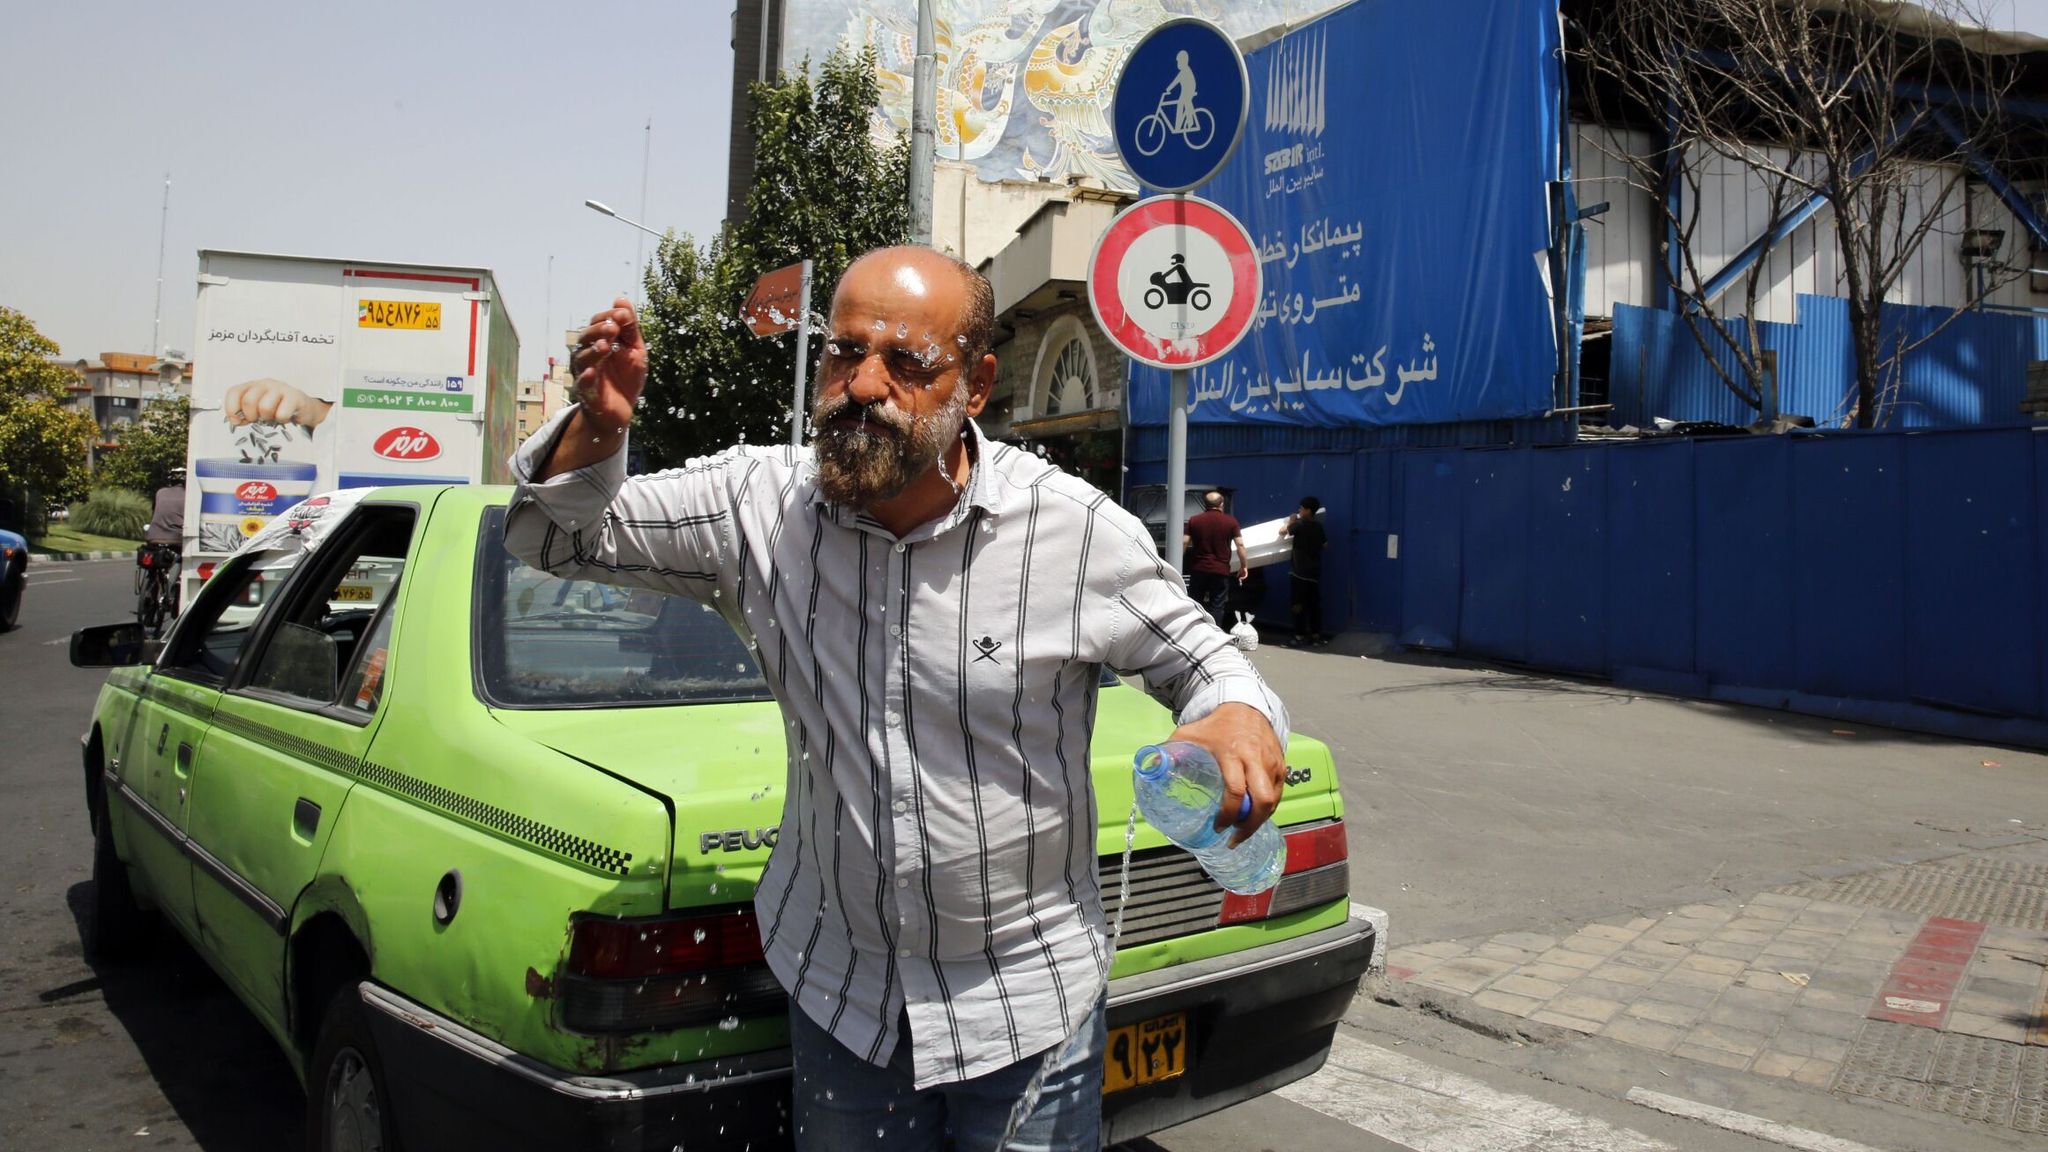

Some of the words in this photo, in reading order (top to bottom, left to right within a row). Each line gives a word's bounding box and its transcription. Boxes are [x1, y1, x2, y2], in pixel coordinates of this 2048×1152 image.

[1286, 217, 1363, 269] پیمانکار
[425, 316, 439, 328] ۵۵
[207, 328, 235, 342] مزمز
[237, 328, 300, 344] آفتابگردان
[301, 334, 334, 345] تخمه
[1346, 332, 1438, 405] شرکت
[447, 380, 463, 390] ۱۵۹
[383, 430, 429, 457] مزمز
